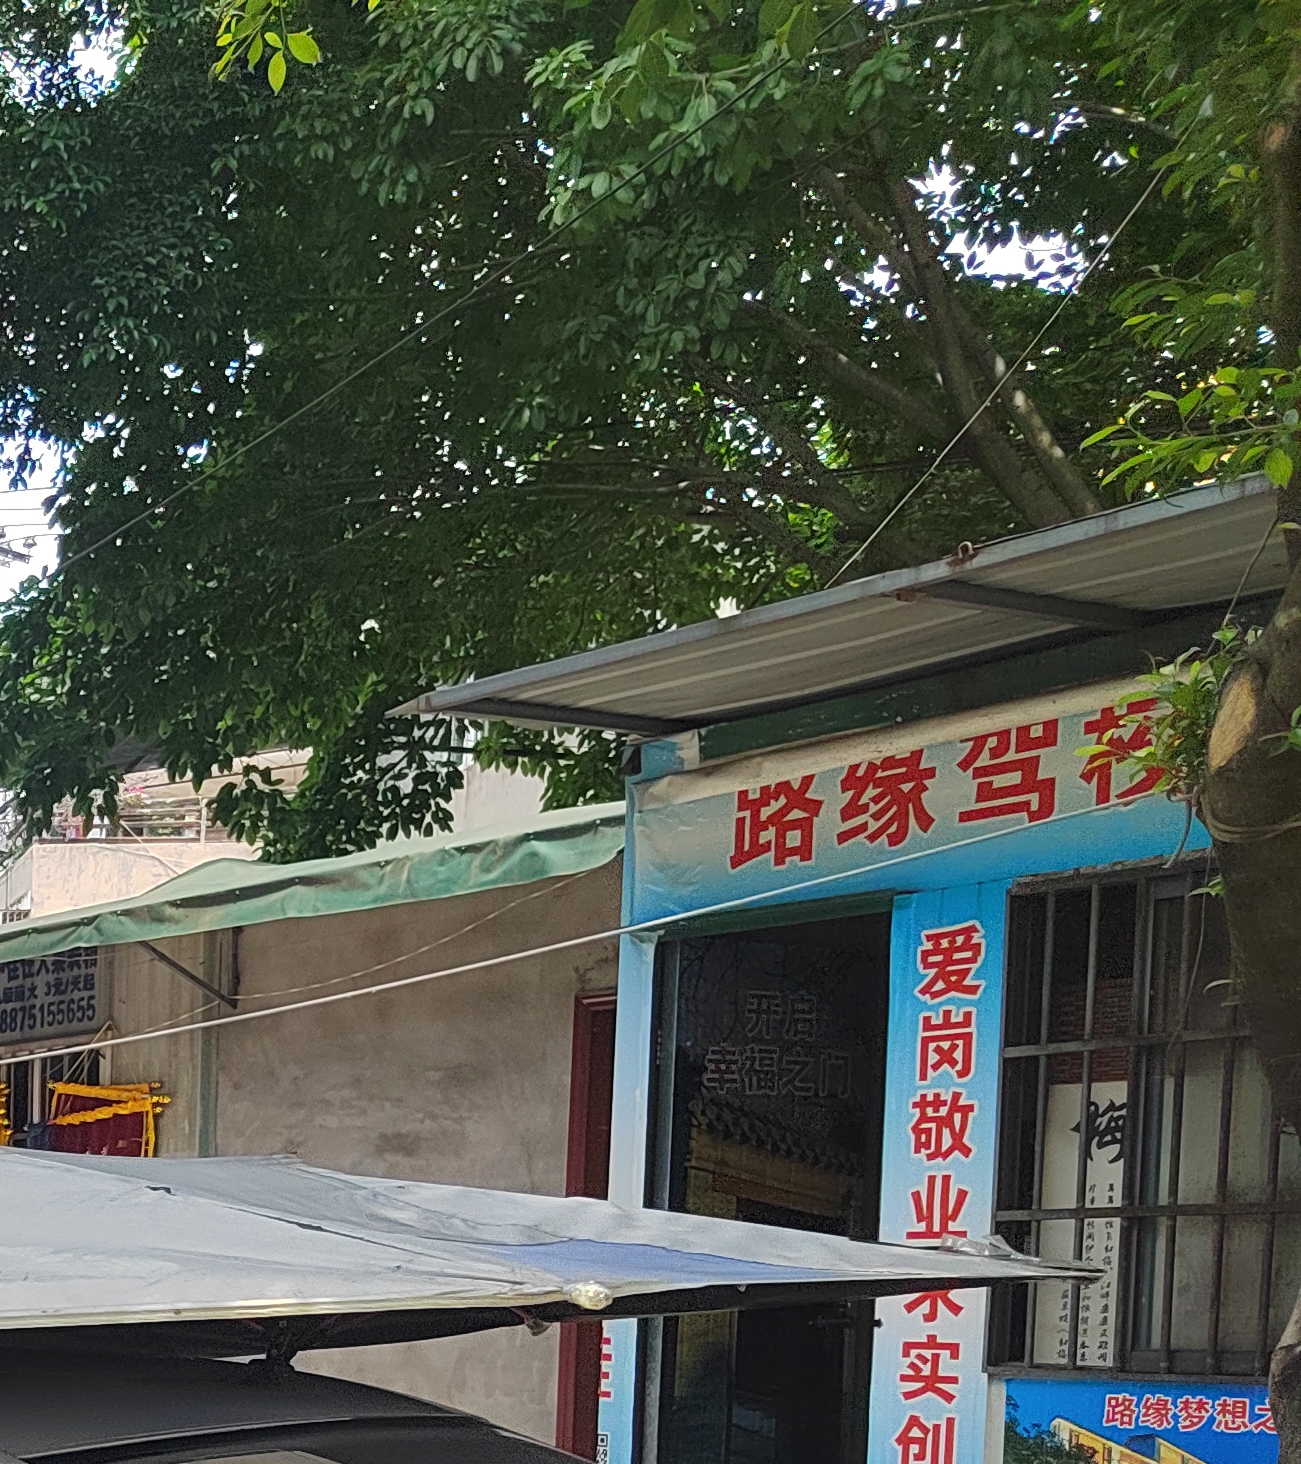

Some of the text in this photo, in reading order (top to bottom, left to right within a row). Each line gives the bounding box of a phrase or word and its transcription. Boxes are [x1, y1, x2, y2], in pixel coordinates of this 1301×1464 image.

[728, 698, 1179, 871] 路缘驾校
[704, 1043, 851, 1098] 幸福之门
